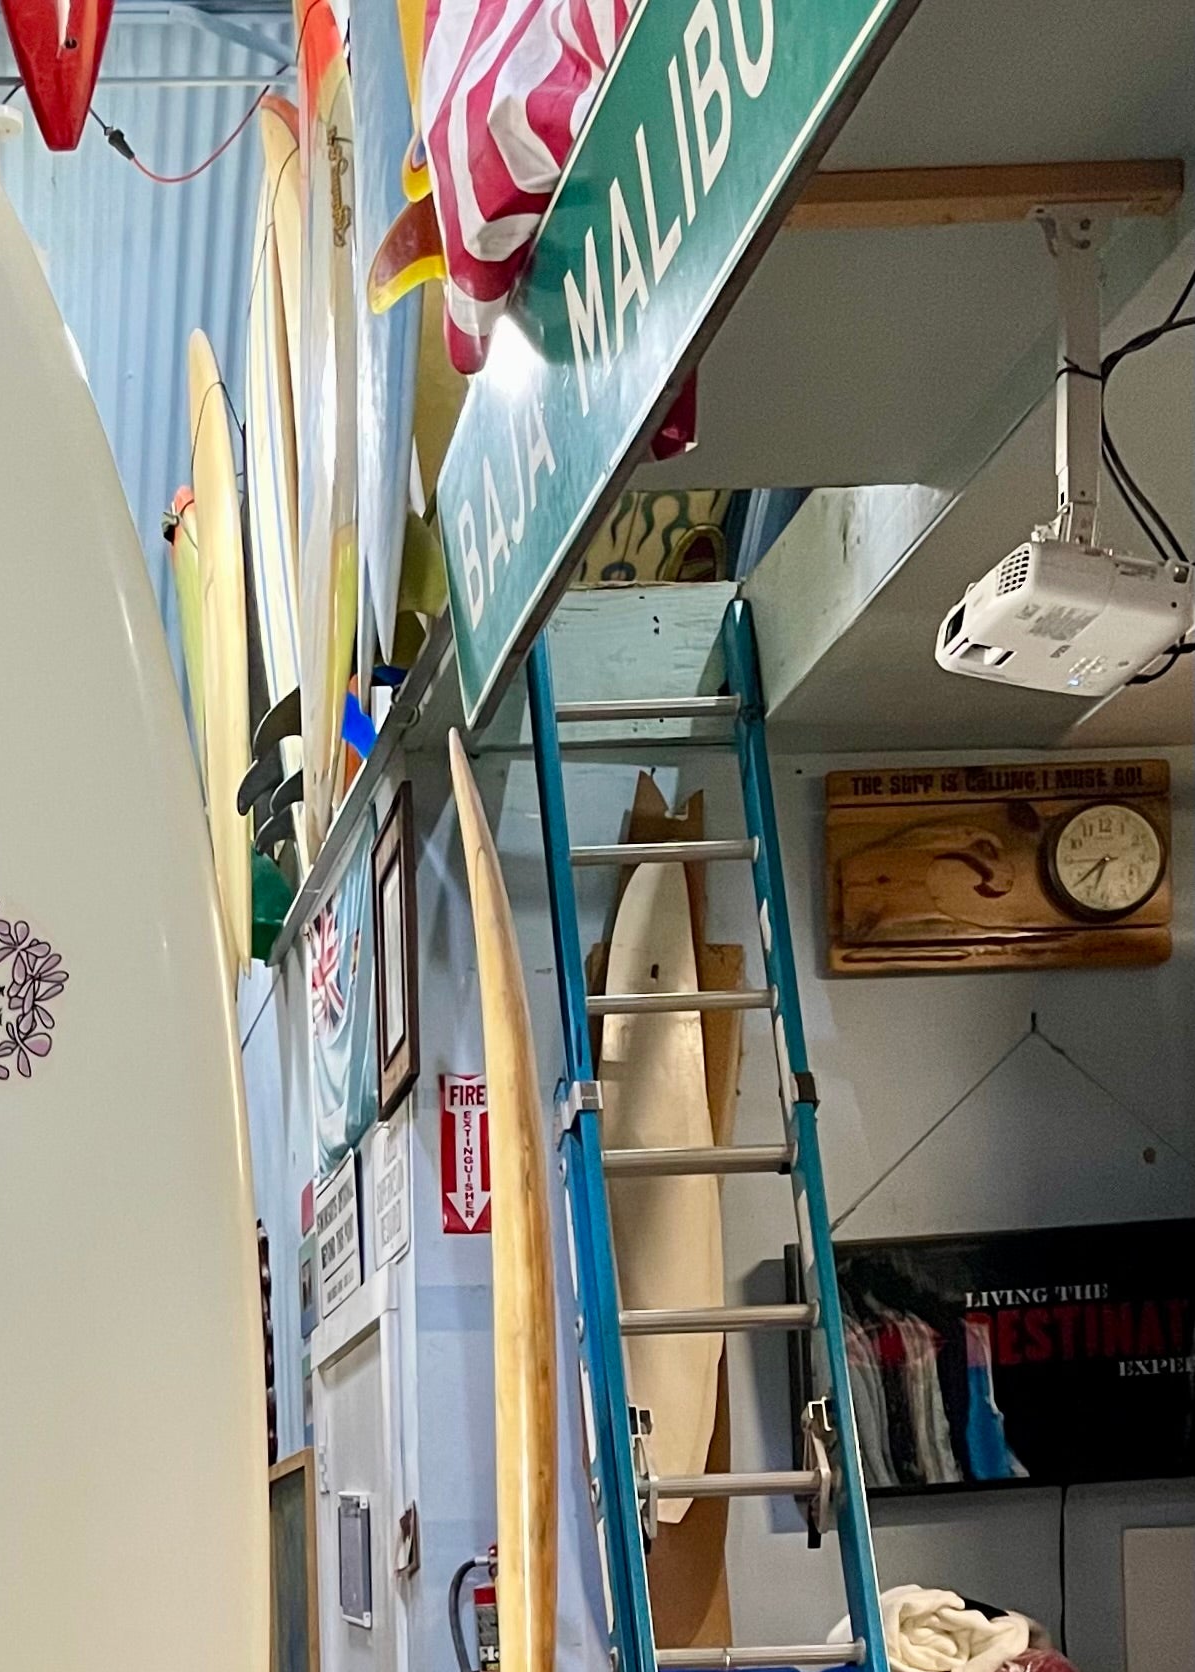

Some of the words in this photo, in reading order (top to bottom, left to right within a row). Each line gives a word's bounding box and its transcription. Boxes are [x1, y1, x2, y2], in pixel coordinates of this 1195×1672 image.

[458, 392, 556, 632] BAJA
[563, 0, 774, 417] MALIBU
[1098, 818, 1112, 833] 12
[449, 1084, 486, 1107] FIRE
[463, 1110, 475, 1218] EXTINGUISHER
[965, 1287, 1049, 1308] LIVING
[1055, 1283, 1109, 1302] THE
